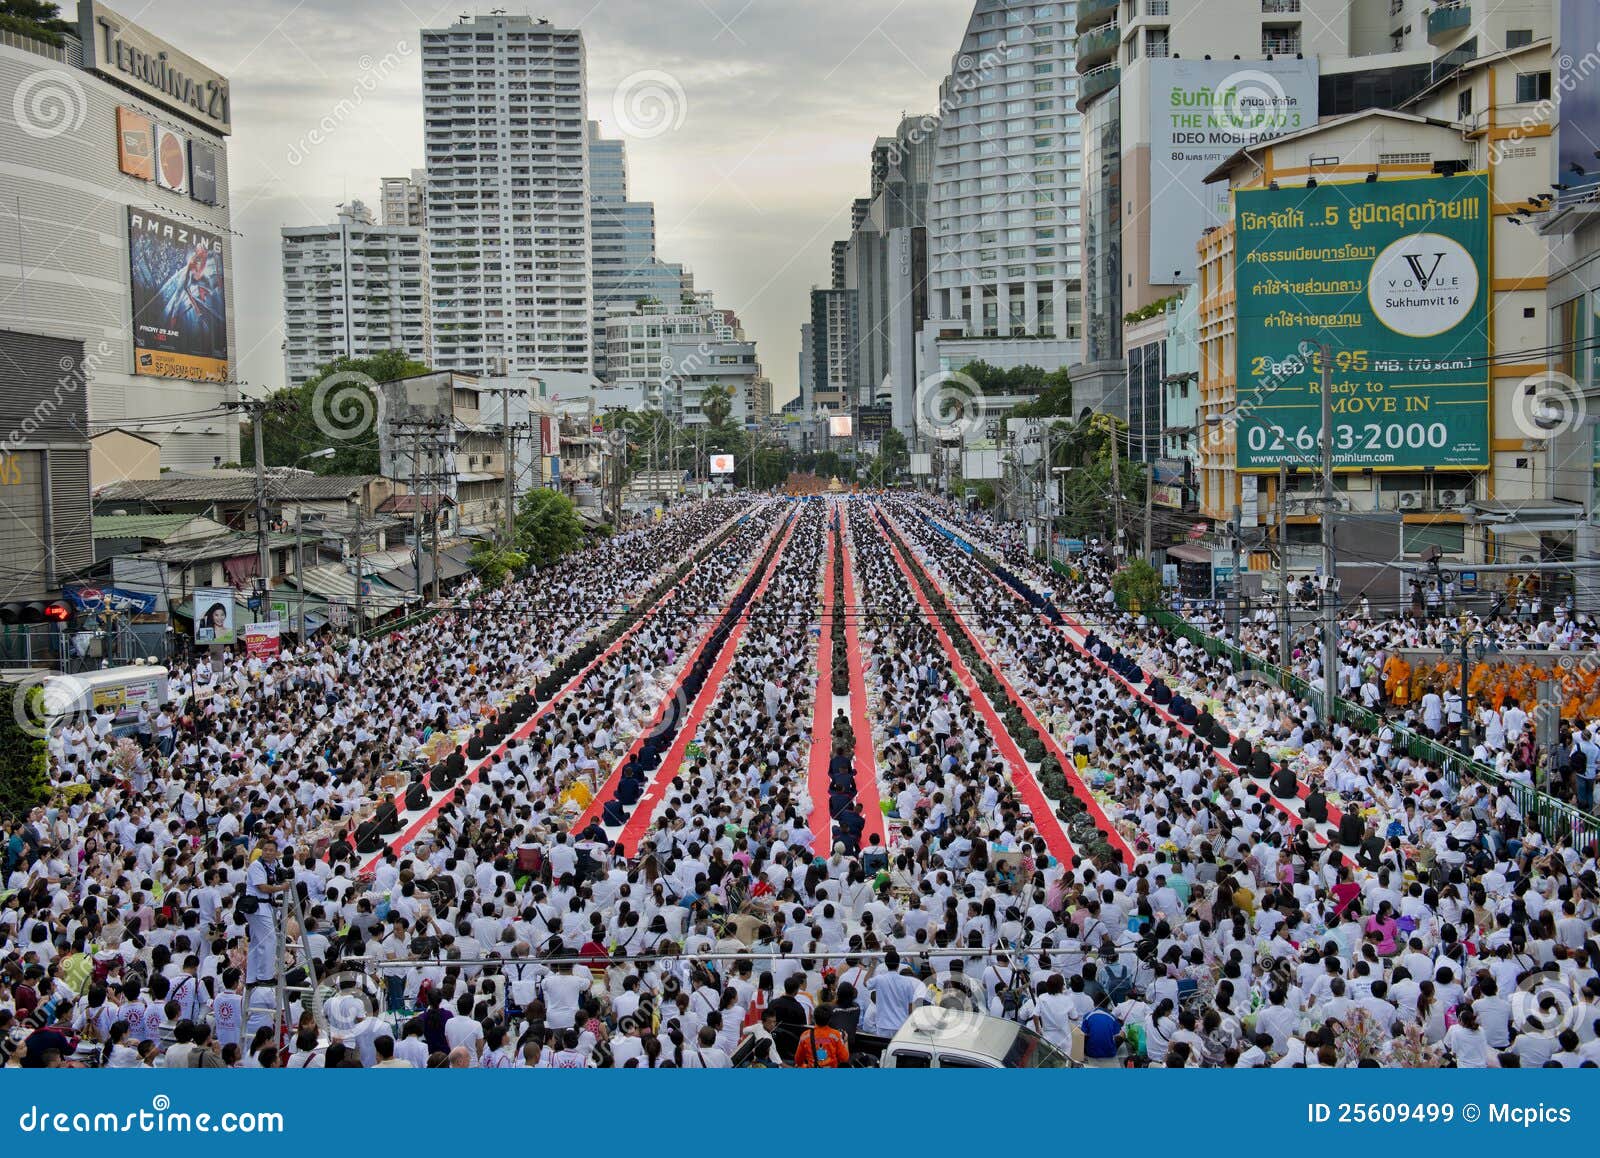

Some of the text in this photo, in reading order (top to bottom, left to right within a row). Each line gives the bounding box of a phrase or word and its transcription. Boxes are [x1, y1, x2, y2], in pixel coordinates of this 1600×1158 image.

[1169, 114, 1202, 128] THE
[1207, 114, 1243, 128] NEW
[1291, 113, 1301, 128] 3
[1172, 132, 1205, 144] IDEO
[1209, 132, 1245, 144] MOBI
[1171, 152, 1184, 161] 80
[131, 214, 222, 253] AMAZING
[1385, 295, 1459, 308] Sukhumvit 16
[1250, 357, 1266, 376] 2
[1308, 381, 1384, 394] Rady to
[1405, 395, 1431, 412] IN
